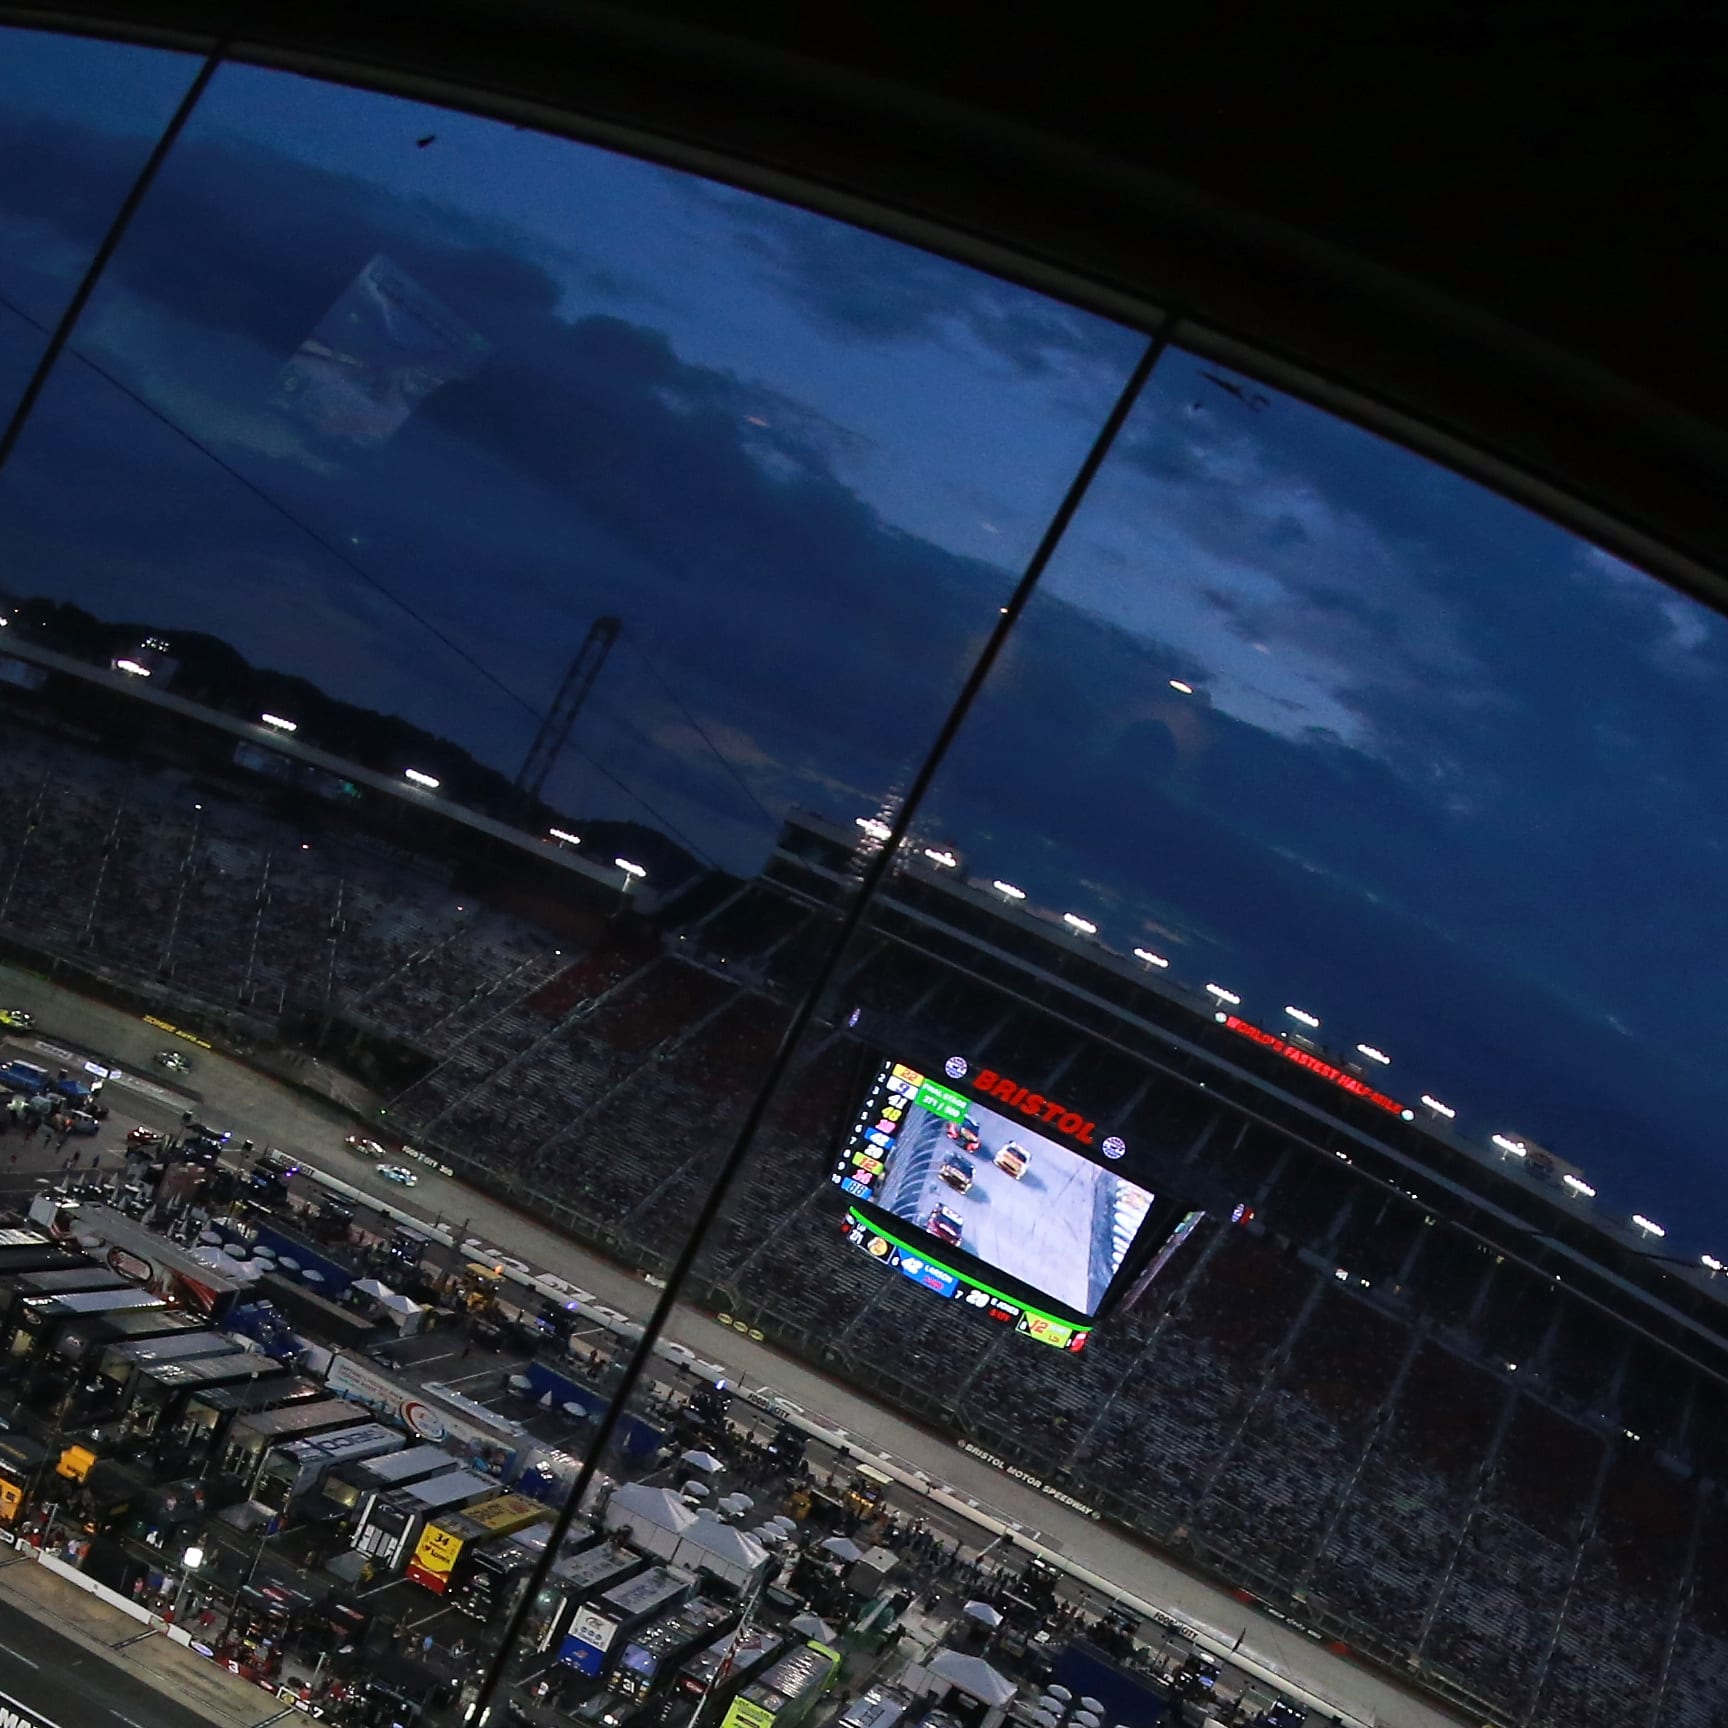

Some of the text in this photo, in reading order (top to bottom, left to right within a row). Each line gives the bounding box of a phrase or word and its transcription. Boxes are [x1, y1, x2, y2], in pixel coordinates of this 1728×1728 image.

[881, 1106, 902, 1122] 48
[973, 1069, 1097, 1145] BRISTOL
[964, 1443, 1094, 1515] BRISTOL MOTOR SPEEDWAY
